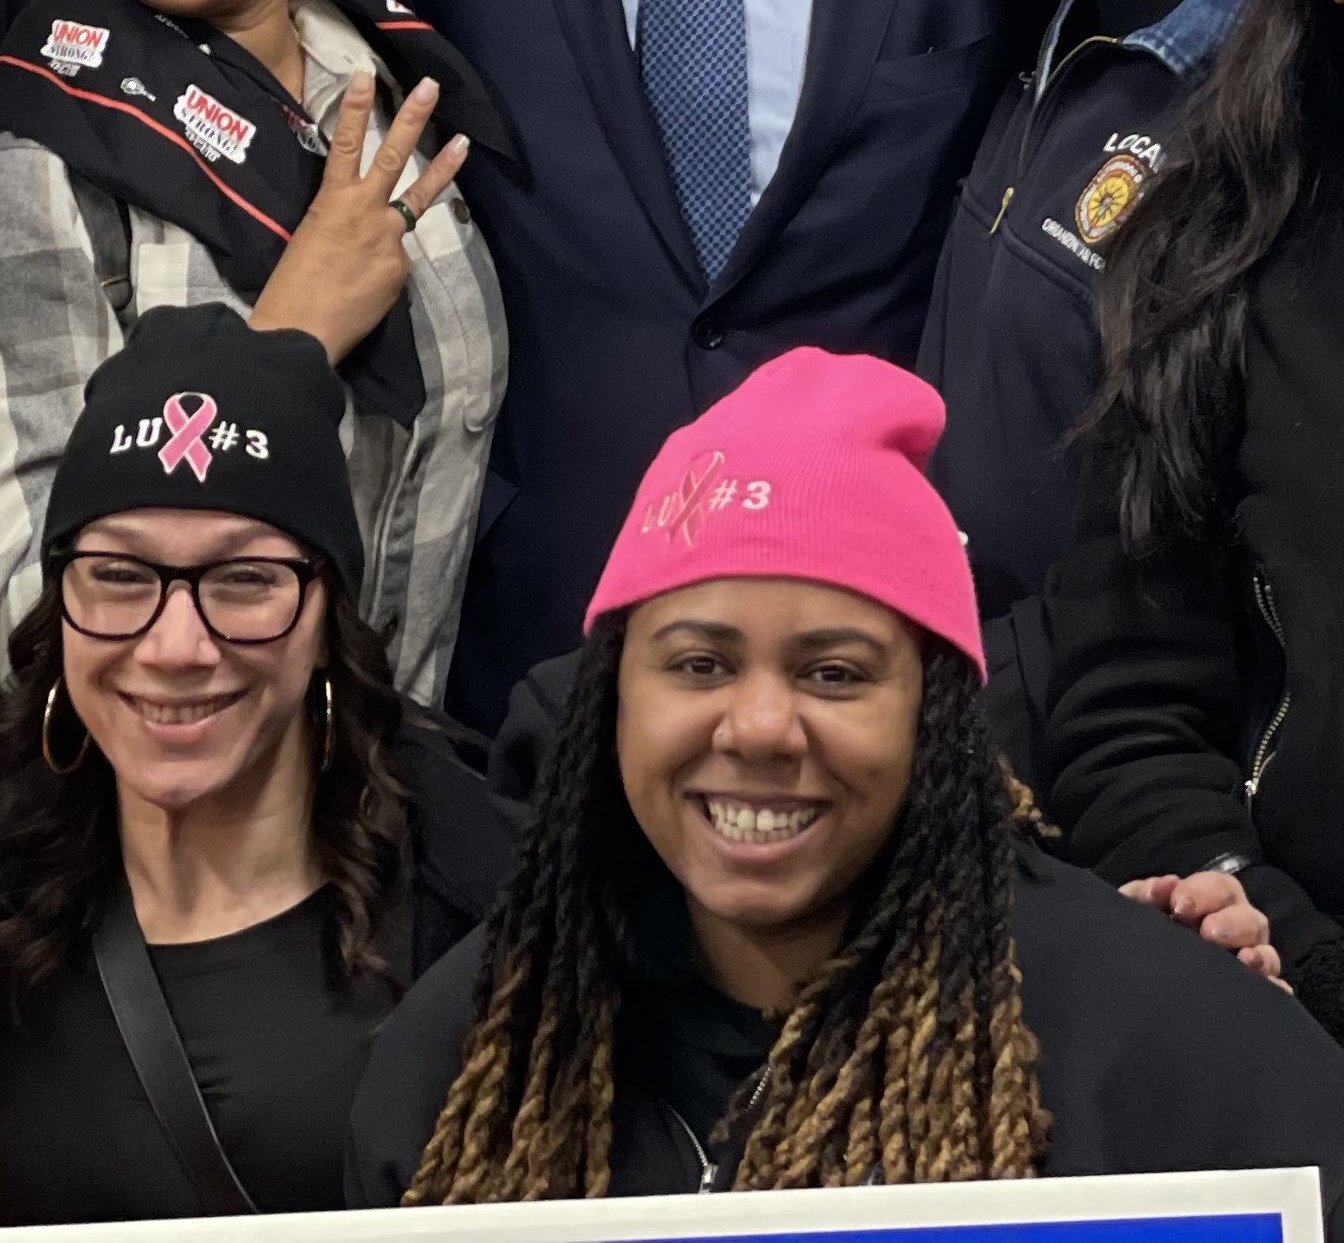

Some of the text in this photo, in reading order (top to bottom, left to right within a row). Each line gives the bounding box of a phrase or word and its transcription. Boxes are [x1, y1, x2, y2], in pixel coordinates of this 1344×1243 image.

[53, 22, 104, 50] UNION
[186, 89, 249, 143] UNION
[109, 417, 270, 460] LU #3
[640, 479, 771, 534] LU #3
